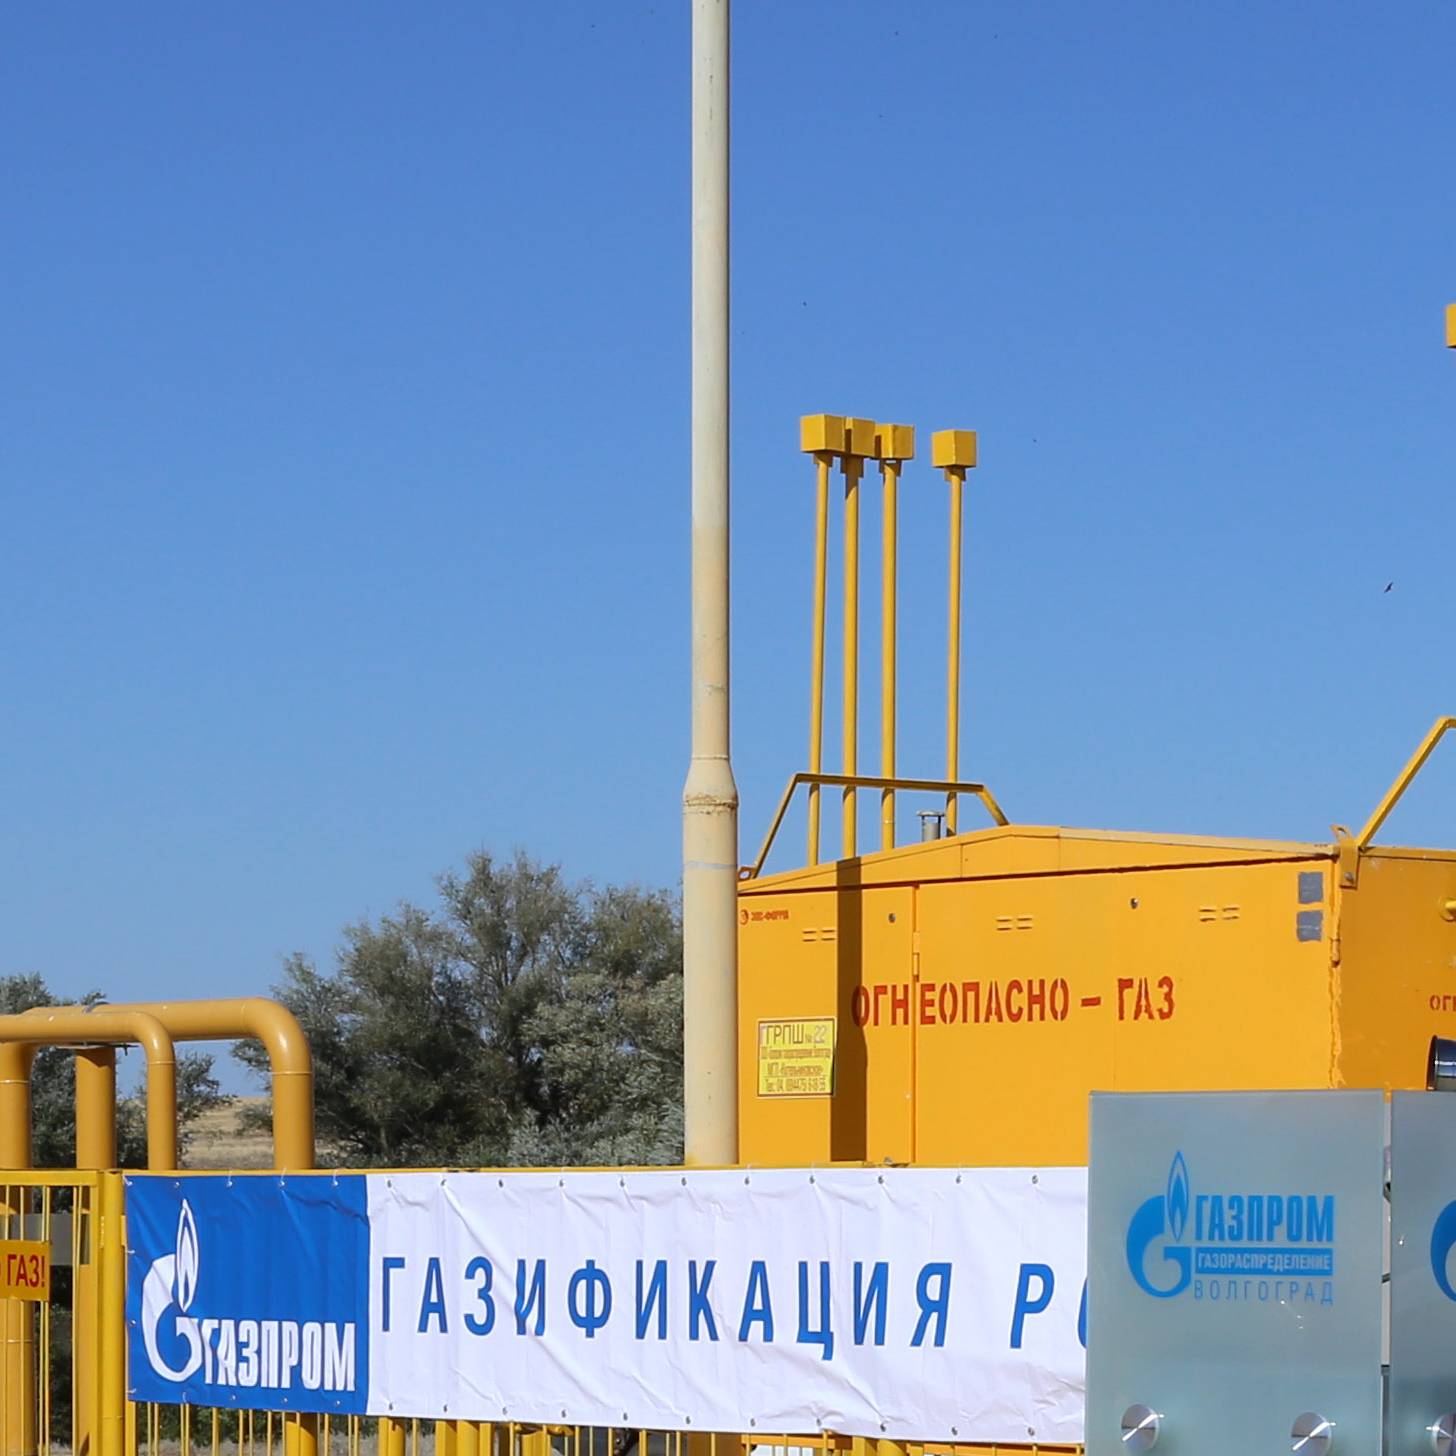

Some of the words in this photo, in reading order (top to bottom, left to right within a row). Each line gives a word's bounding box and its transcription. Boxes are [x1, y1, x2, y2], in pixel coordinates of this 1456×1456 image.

[852, 978, 1069, 1026] ОГНЕОПАСНО
[1118, 976, 1174, 1021] ГАЗ
[1195, 1195, 1334, 1242] ГАЗПРОМ
[7, 1254, 45, 1287] ГАЗ!
[1198, 1253, 1331, 1273] ГАЗОРАСПРЕДЕЛЕНИЕ
[381, 1257, 952, 1361] ГАЗИФИКАЦИЯ
[1009, 1263, 1088, 1350] Р
[1194, 1280, 1333, 1305] ВОЛГОГРАД
[202, 1319, 356, 1391] ГАЗПРОМ
